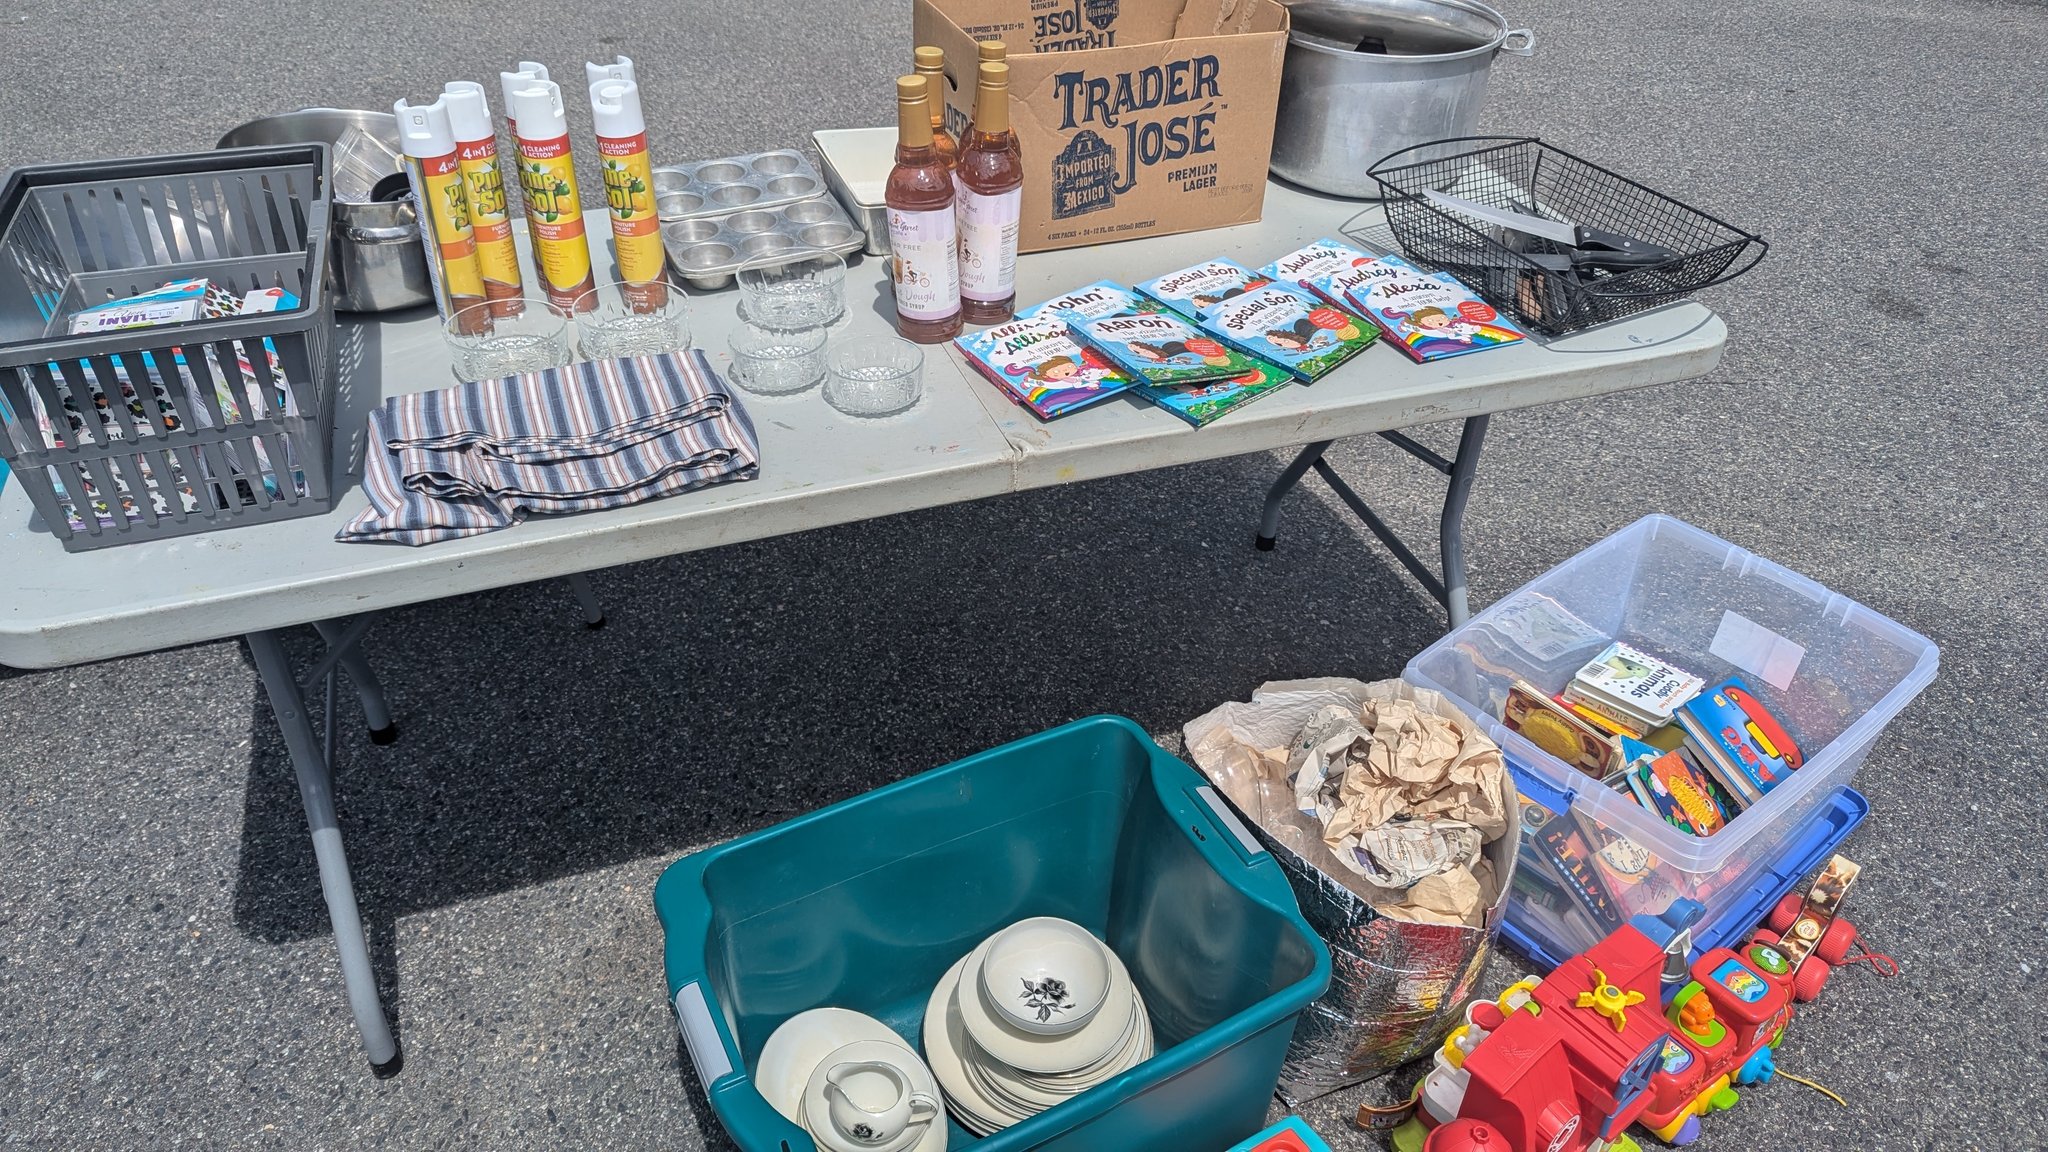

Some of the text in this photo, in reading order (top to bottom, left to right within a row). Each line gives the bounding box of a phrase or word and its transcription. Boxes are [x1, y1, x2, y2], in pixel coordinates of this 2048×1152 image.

[1031, 2, 1058, 11] PREMIUM
[1033, 0, 1085, 43] JOSÉ
[1053, 55, 1223, 131] TRADER
[527, 143, 561, 152] CLEANING
[604, 141, 637, 150] CLEANING
[1110, 102, 1217, 194] JOSÉ
[1055, 153, 1110, 184] IMPORTED
[1167, 163, 1217, 183] PREMIUM
[1075, 174, 1094, 189] FROM
[1183, 176, 1217, 192] LAGER
[1062, 185, 1105, 214] MEXICO
[1052, 232, 1061, 240] SIX
[1060, 231, 1077, 239] PACKS
[1135, 220, 1156, 229] BOTTLES
[903, 243, 922, 252] FREE
[1282, 248, 1338, 274] Audrey
[1337, 267, 1398, 290] Audrey
[905, 291, 936, 303] Dough
[1382, 282, 1442, 299] Alexa
[909, 302, 925, 310] SYRUP
[1099, 316, 1173, 334] Aaron
[1251, 317, 1263, 327] The
[1004, 326, 1075, 356] Allison
[1630, 666, 1675, 698] Animals
[1652, 680, 1680, 700] Cuddly
[1541, 710, 1575, 733] Cuddly Puppy
[1596, 704, 1629, 723] ANIMALS
[1721, 725, 1777, 782] ABC
